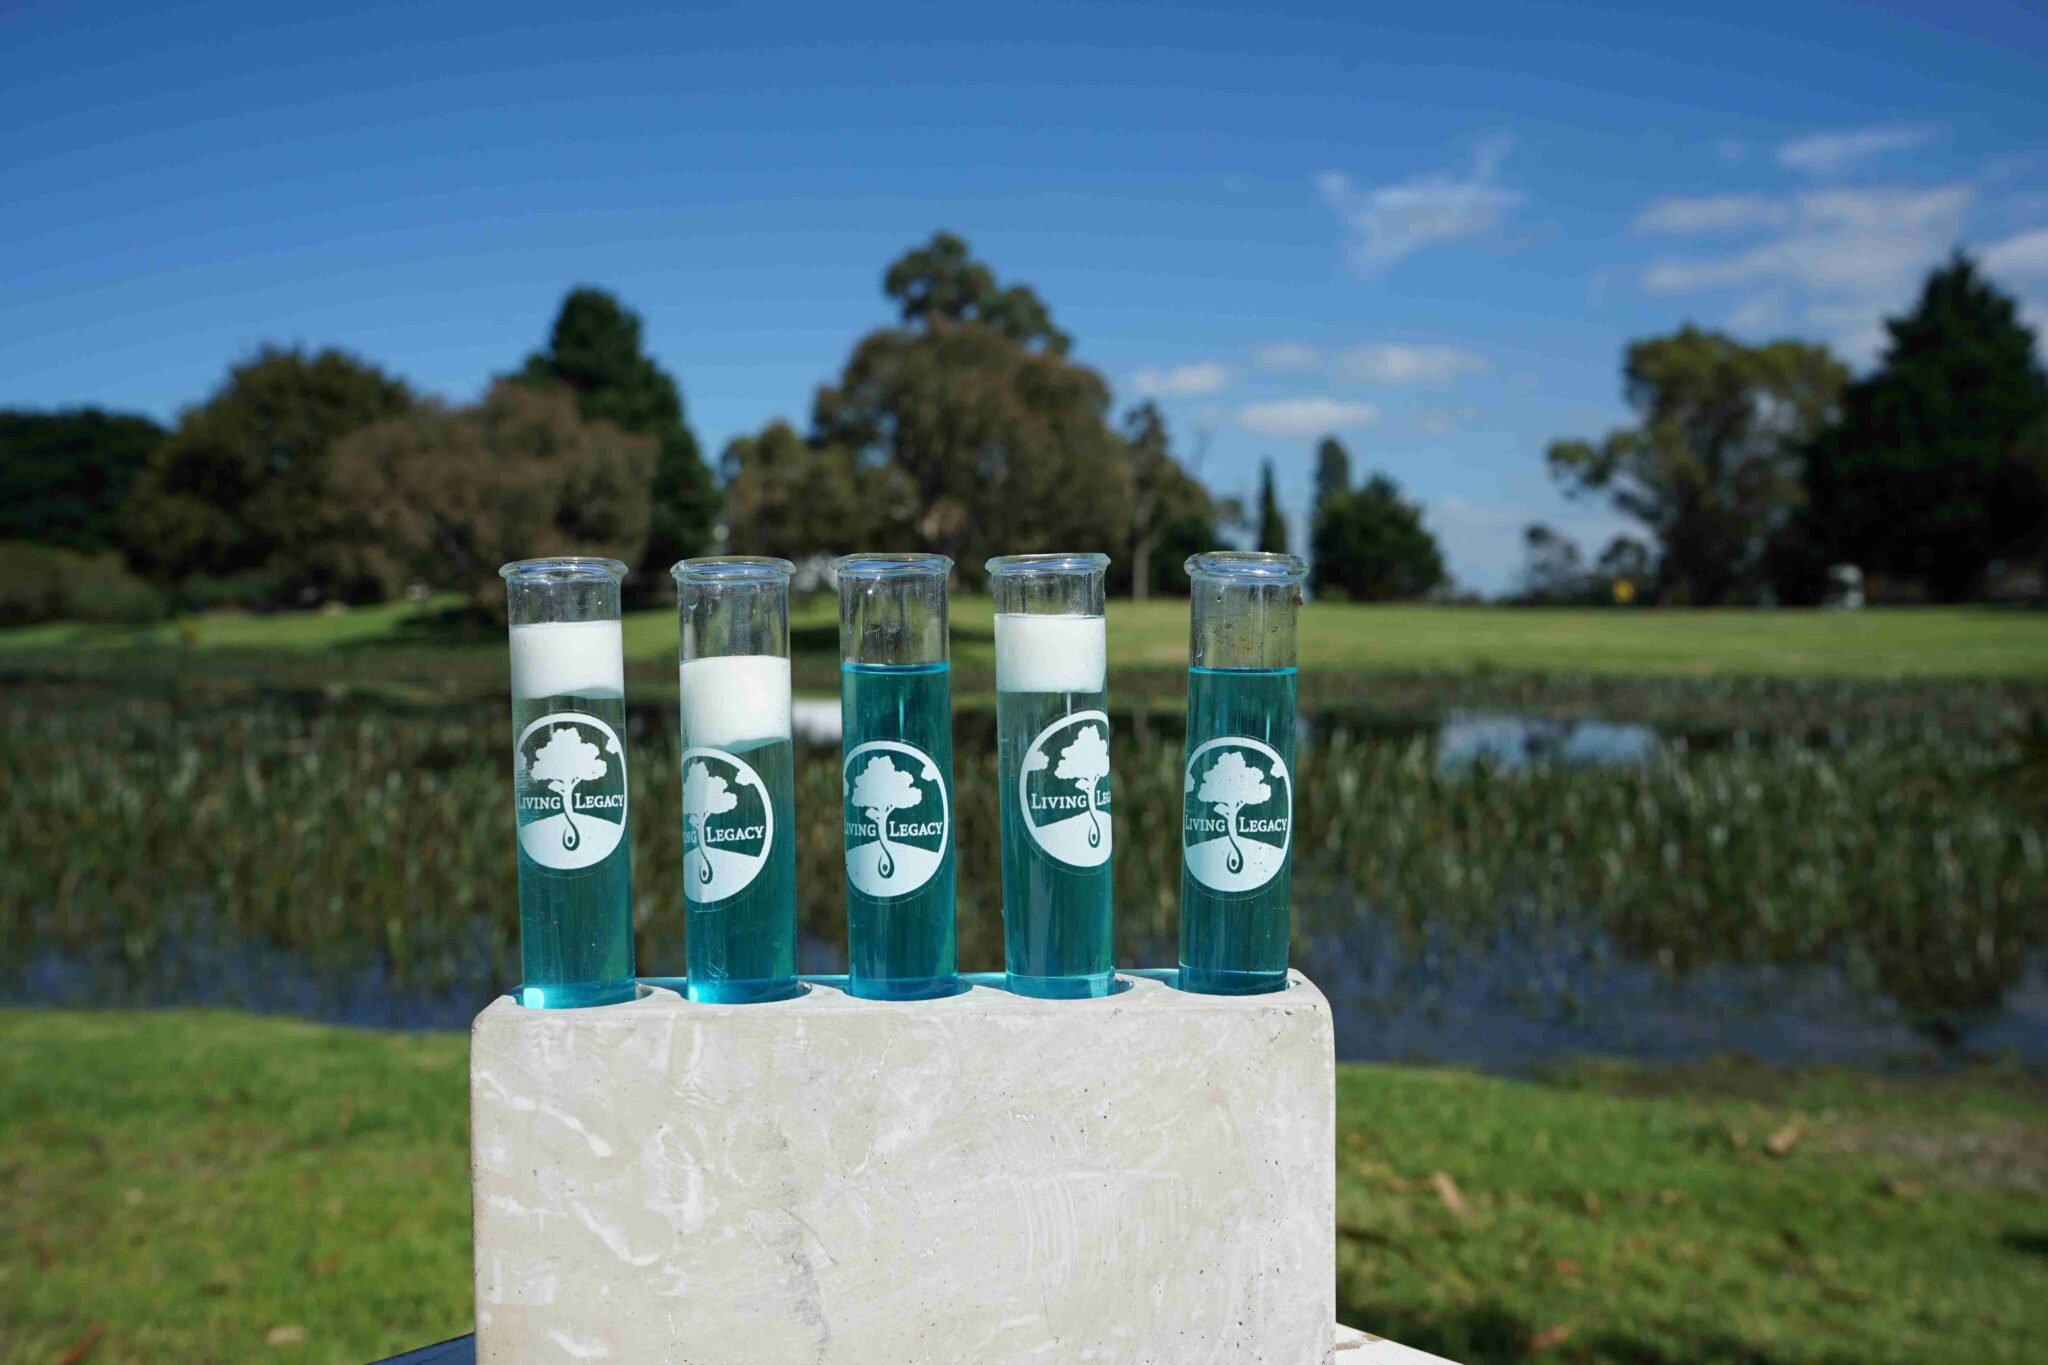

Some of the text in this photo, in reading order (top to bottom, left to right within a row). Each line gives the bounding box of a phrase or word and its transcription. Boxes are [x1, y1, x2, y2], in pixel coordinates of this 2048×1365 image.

[517, 792, 625, 810] LIVING LEGACY
[1031, 792, 1087, 810] LIVING
[888, 820, 943, 837] LEGACY
[1185, 813, 1288, 833] LIVING LEGACY
[705, 825, 765, 843] LEGACY
